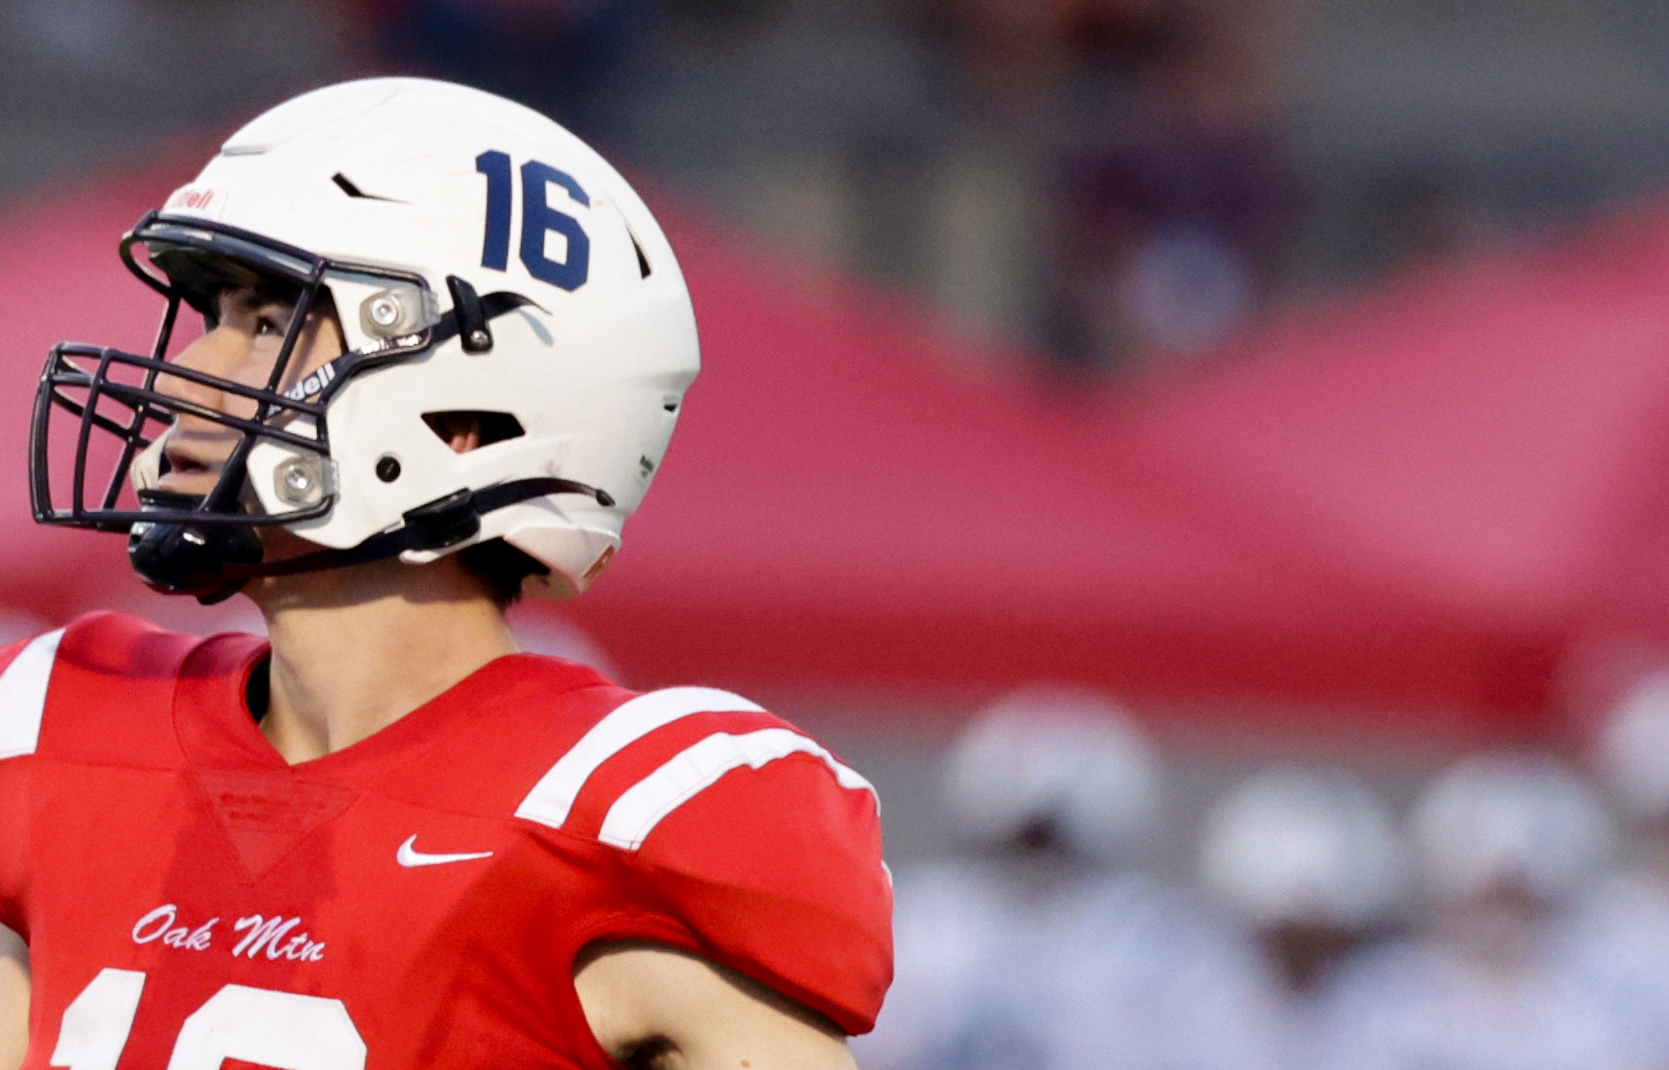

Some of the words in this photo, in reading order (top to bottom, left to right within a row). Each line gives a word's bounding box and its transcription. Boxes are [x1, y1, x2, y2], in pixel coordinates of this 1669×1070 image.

[475, 149, 590, 292] 16
[132, 903, 220, 950] Oak
[231, 914, 326, 962] Mtn
